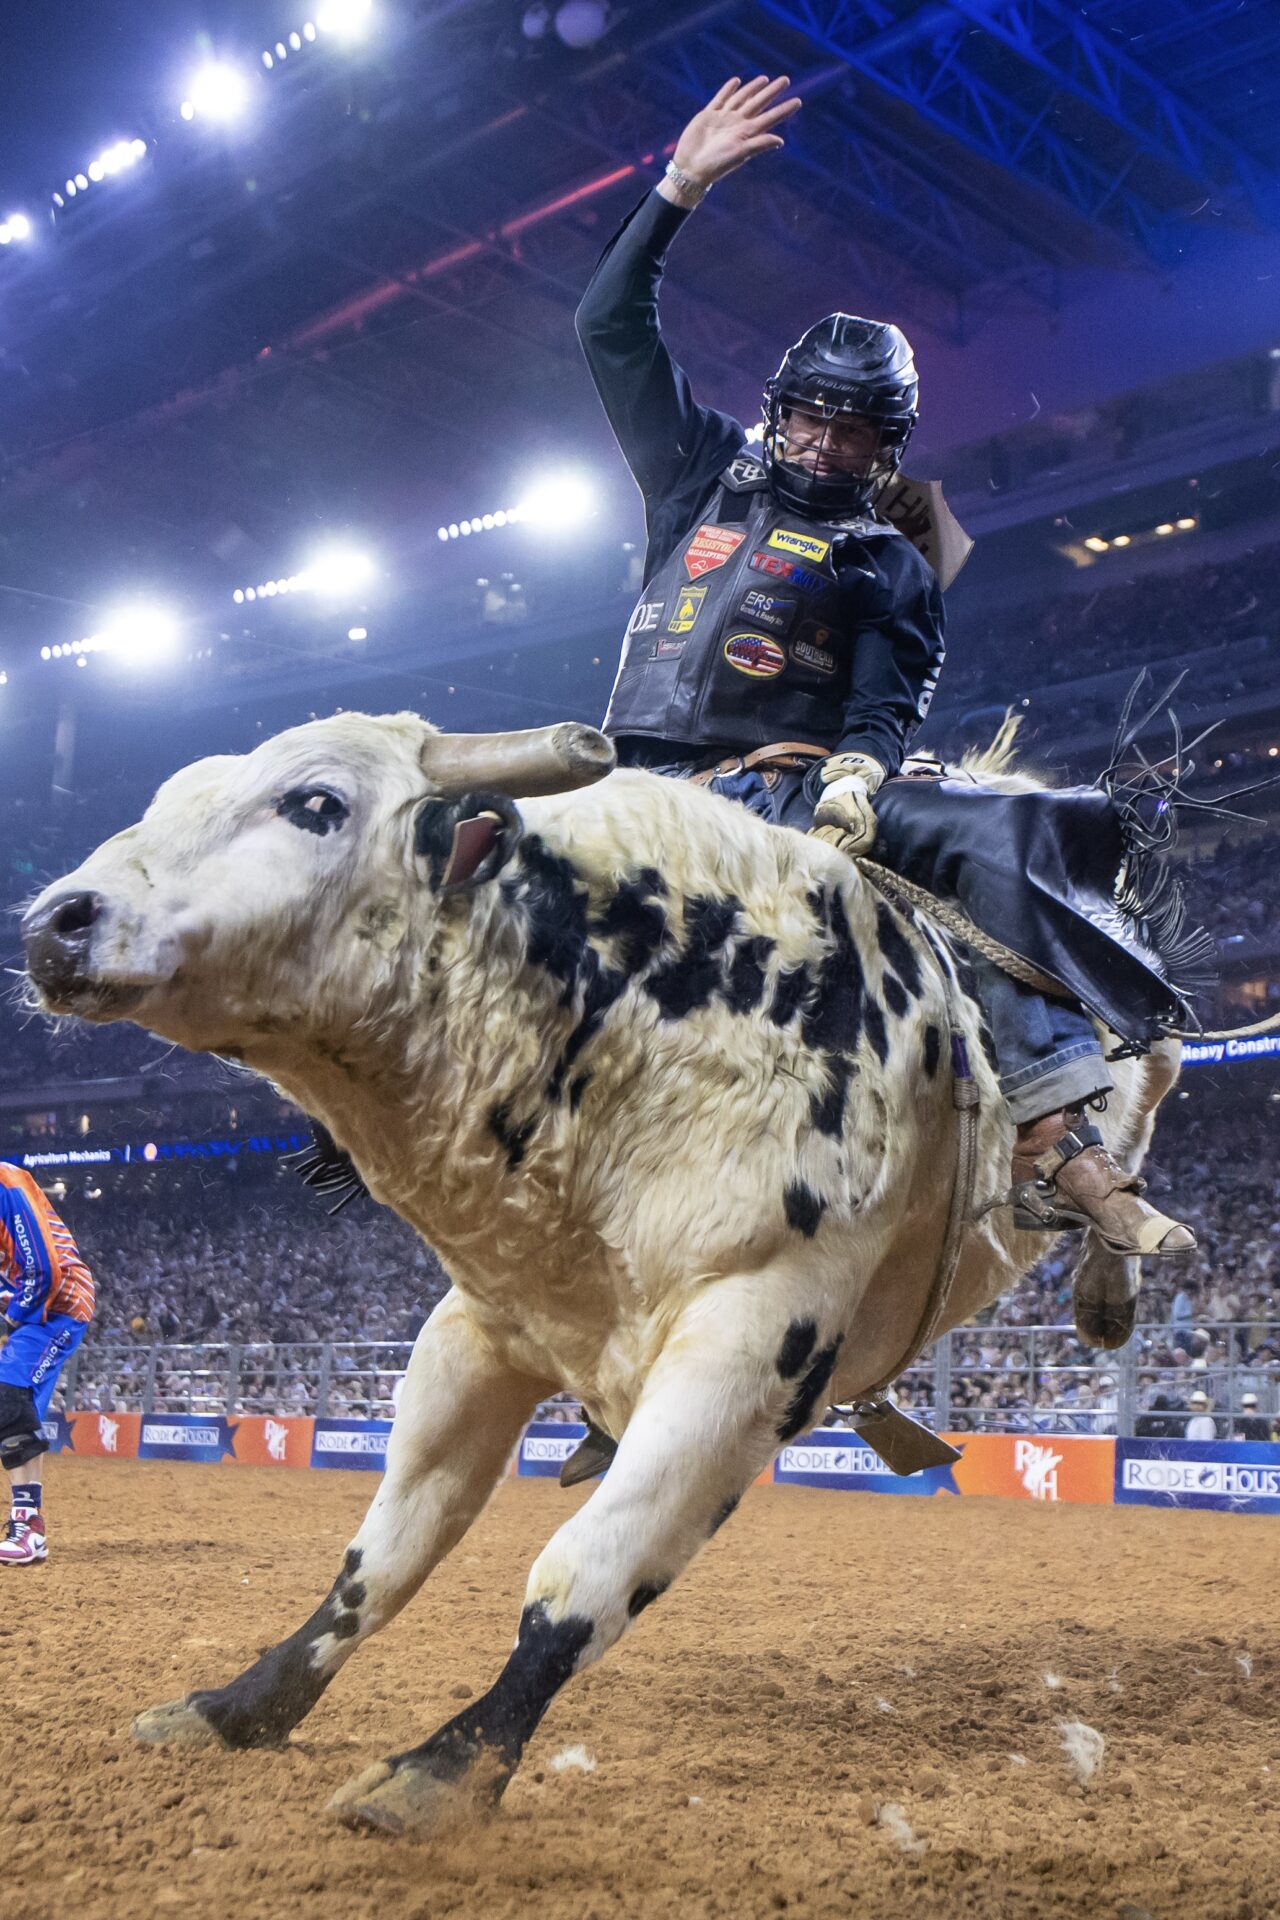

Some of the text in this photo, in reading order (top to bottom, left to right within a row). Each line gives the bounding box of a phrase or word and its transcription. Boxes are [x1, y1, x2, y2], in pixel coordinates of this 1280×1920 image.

[776, 532, 825, 554] Wrangler
[744, 591, 774, 611] ERS
[1181, 1044, 1225, 1062] Heavy
[23, 1149, 111, 1167] Agriculture Mechanics
